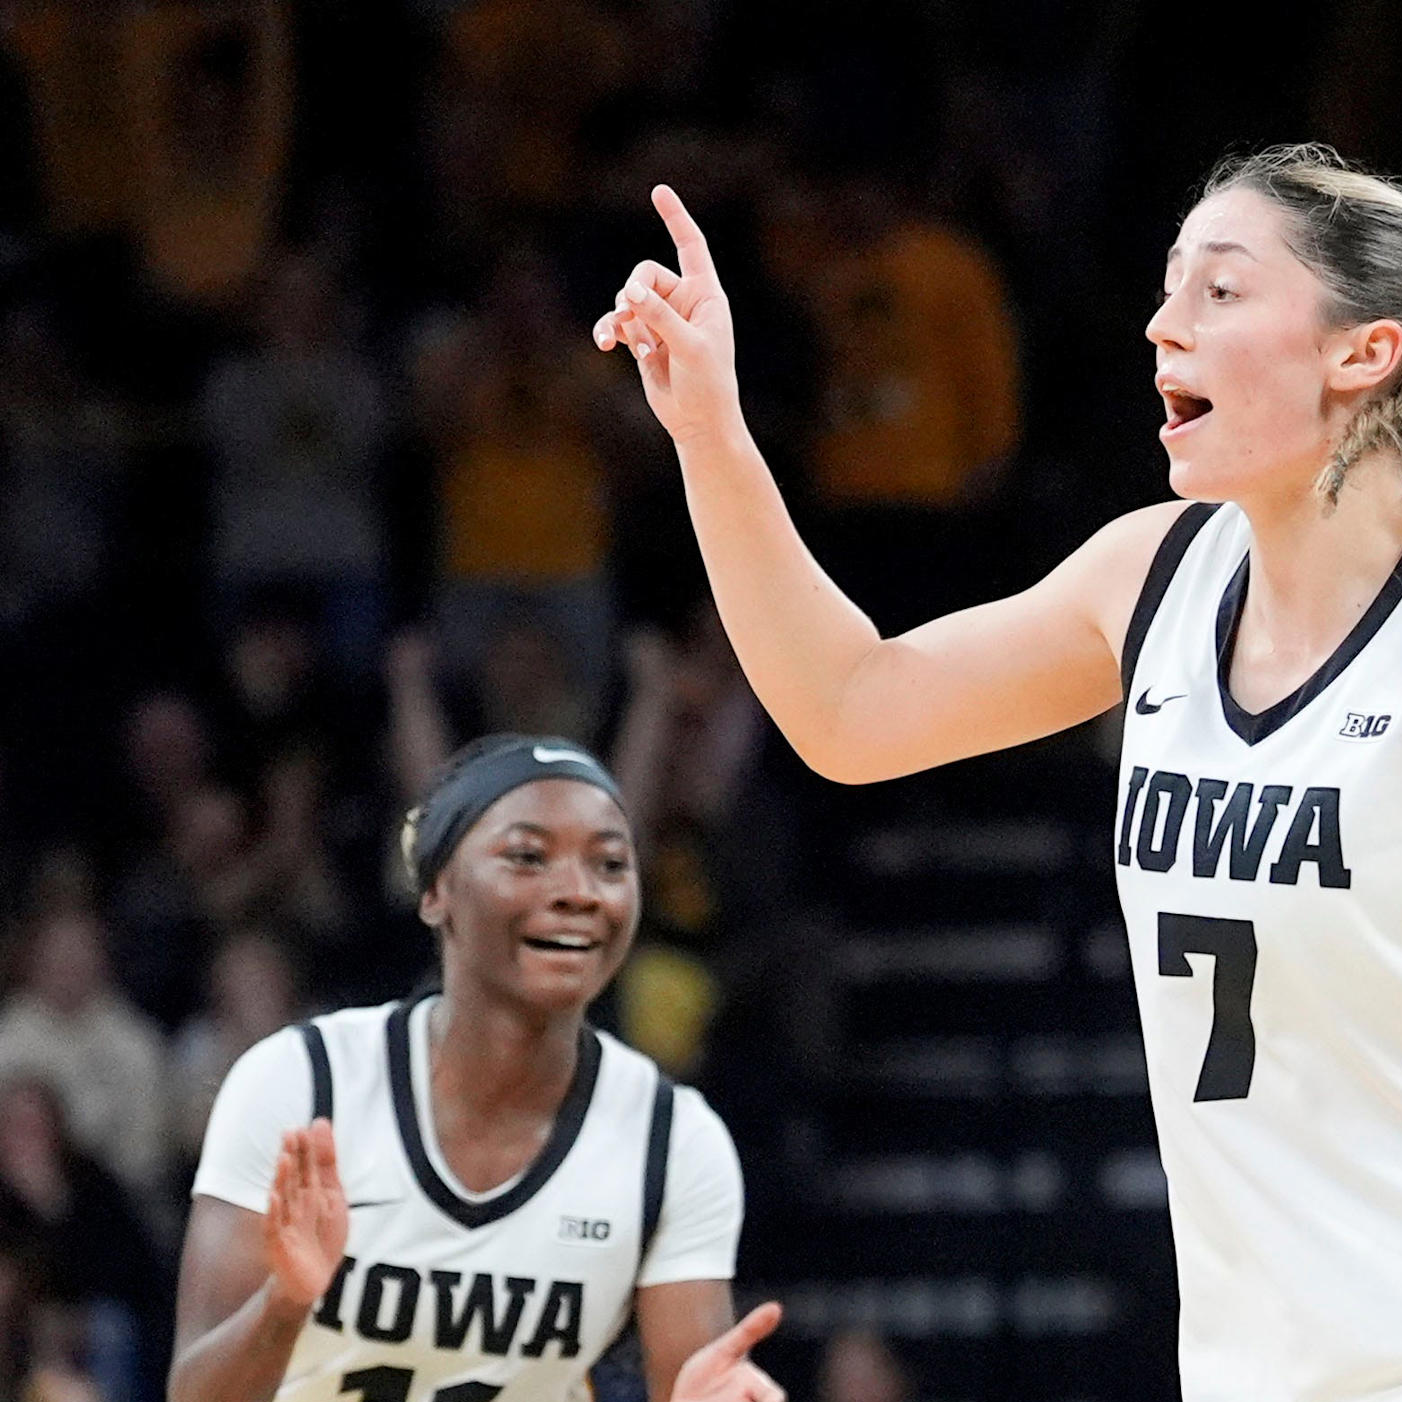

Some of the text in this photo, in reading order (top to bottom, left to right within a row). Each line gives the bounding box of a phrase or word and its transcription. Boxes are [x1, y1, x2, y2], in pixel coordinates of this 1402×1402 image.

[1117, 765, 1351, 889] IOWA
[1157, 911, 1258, 1103] 7
[313, 1256, 586, 1358] IOWA
